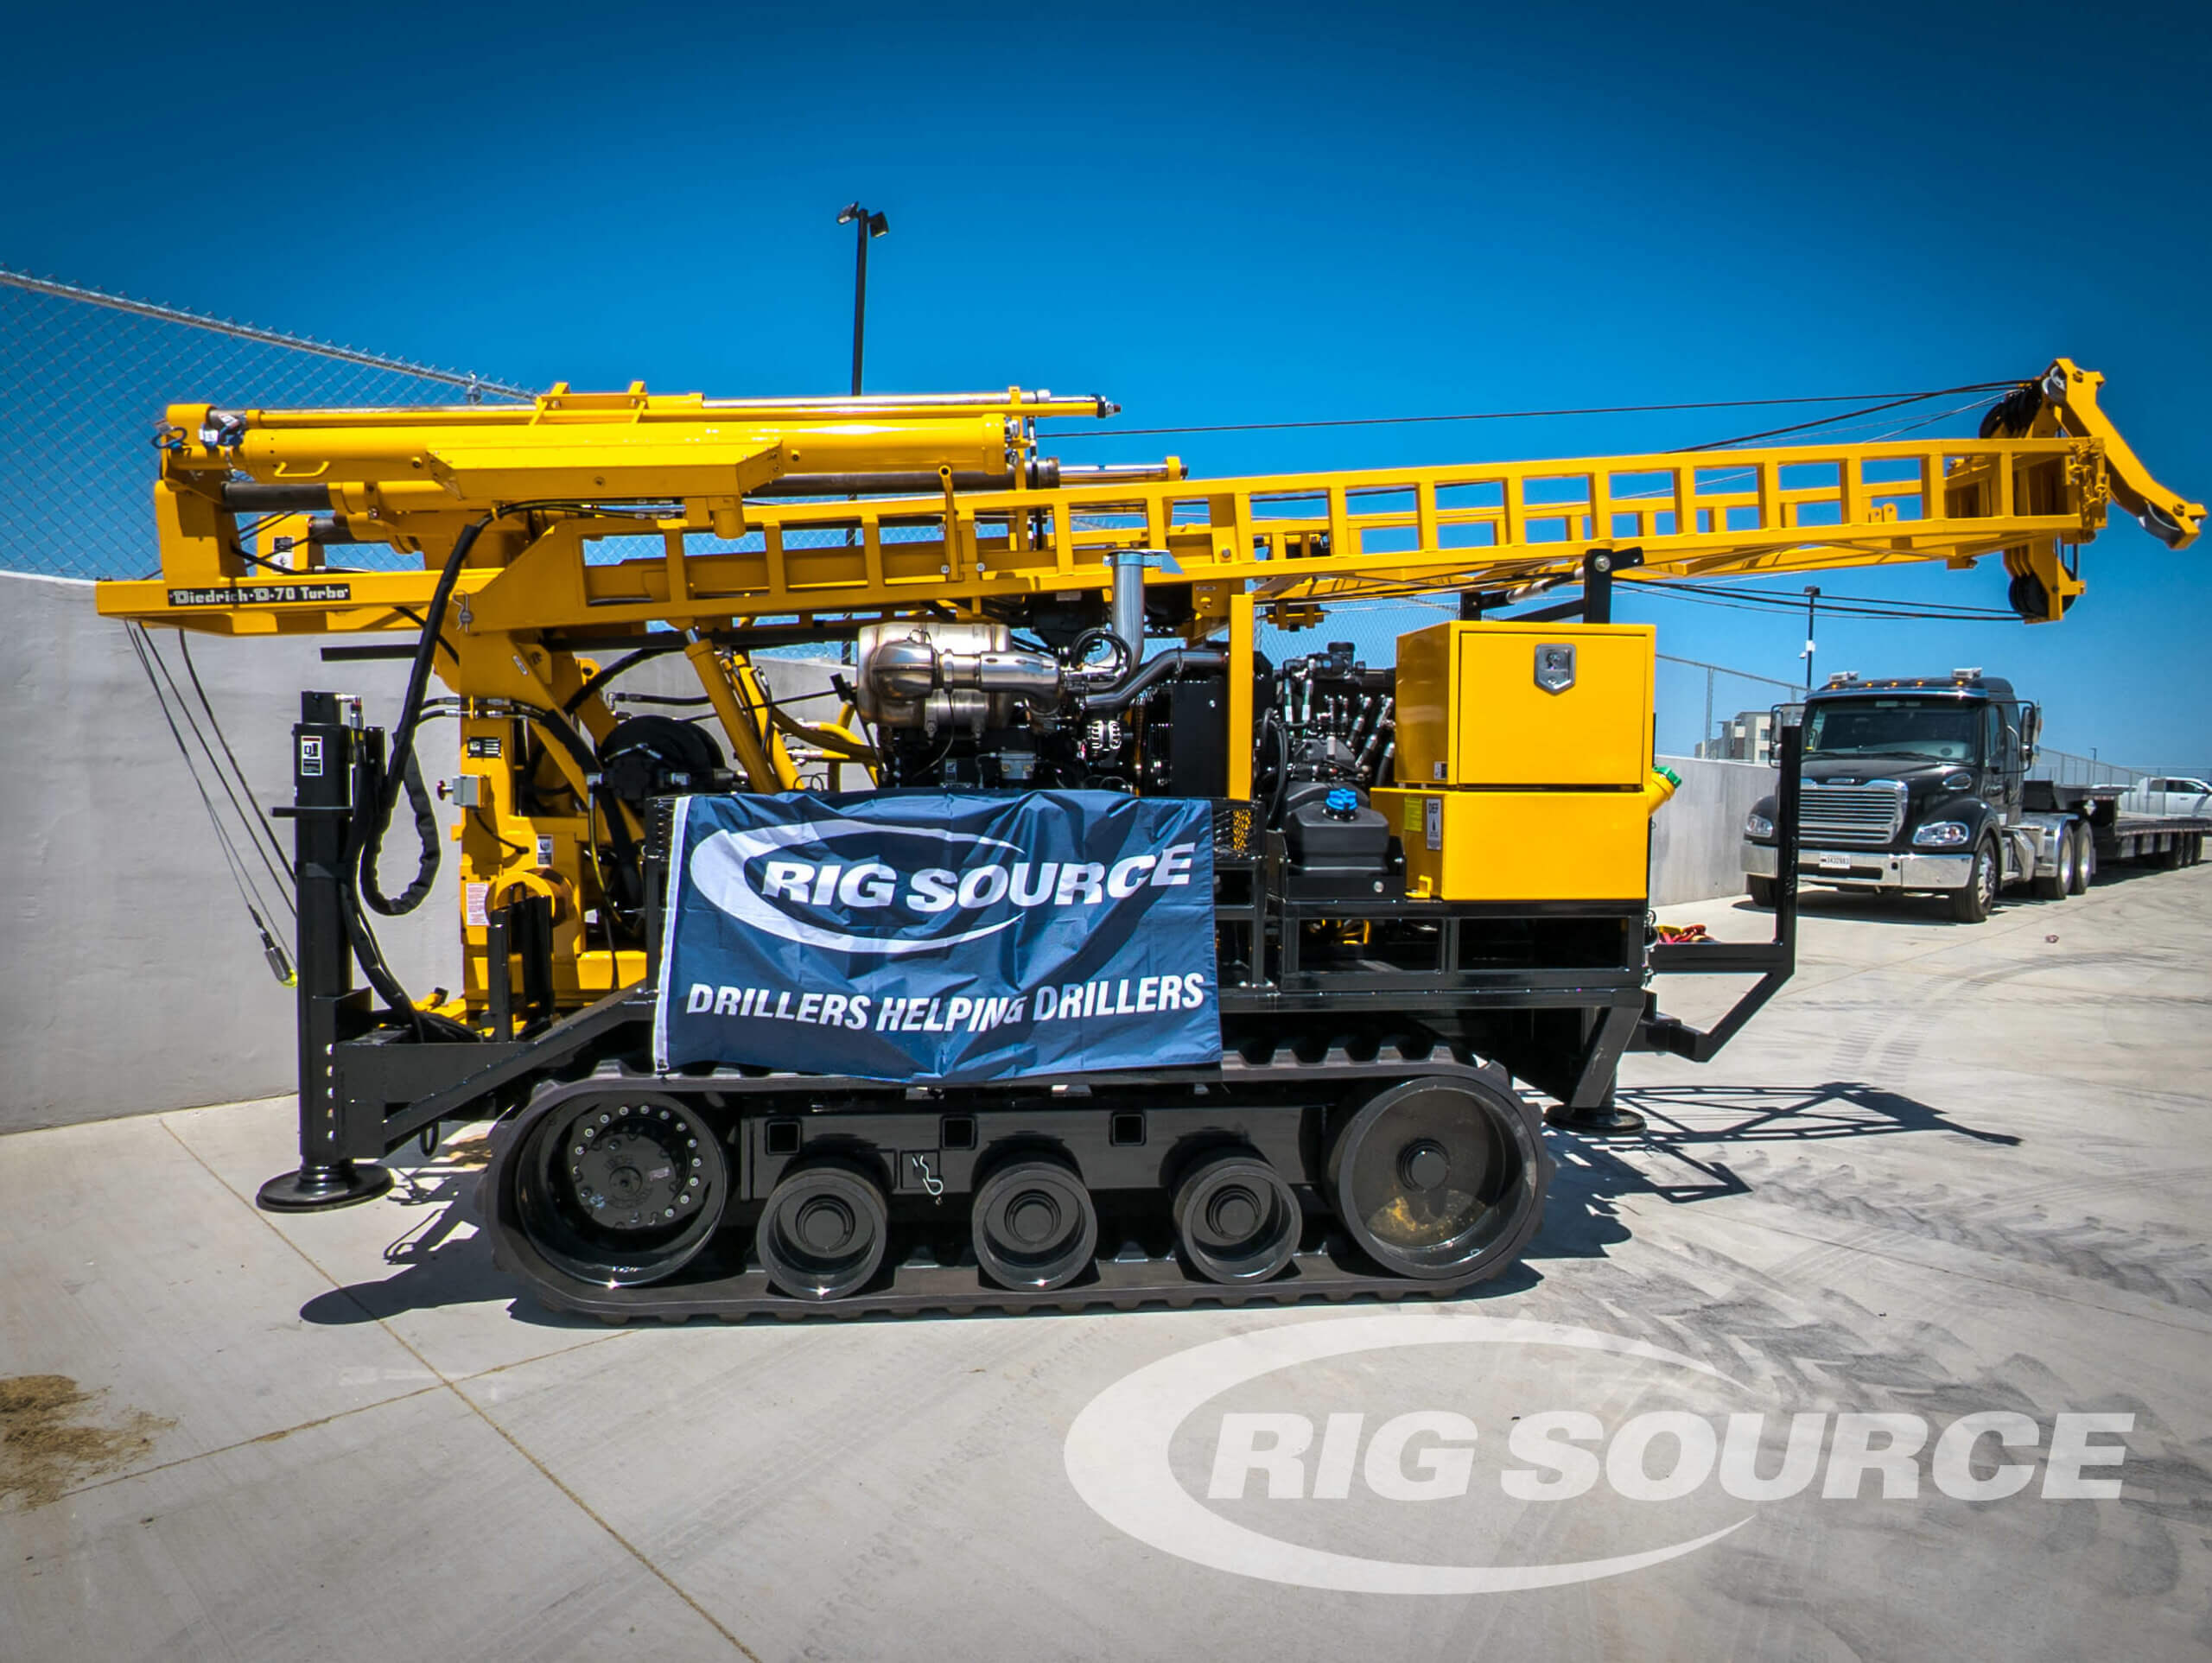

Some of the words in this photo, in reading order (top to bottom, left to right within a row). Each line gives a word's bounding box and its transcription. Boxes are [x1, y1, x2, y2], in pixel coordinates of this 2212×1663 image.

[300, 586, 346, 600] Turbo
[761, 860, 897, 908] RIG
[906, 842, 1196, 913] SOURCE
[686, 983, 871, 1030] DRILLERS
[875, 994, 1027, 1033] HELPING
[1033, 973, 1205, 1022] DRILLERS
